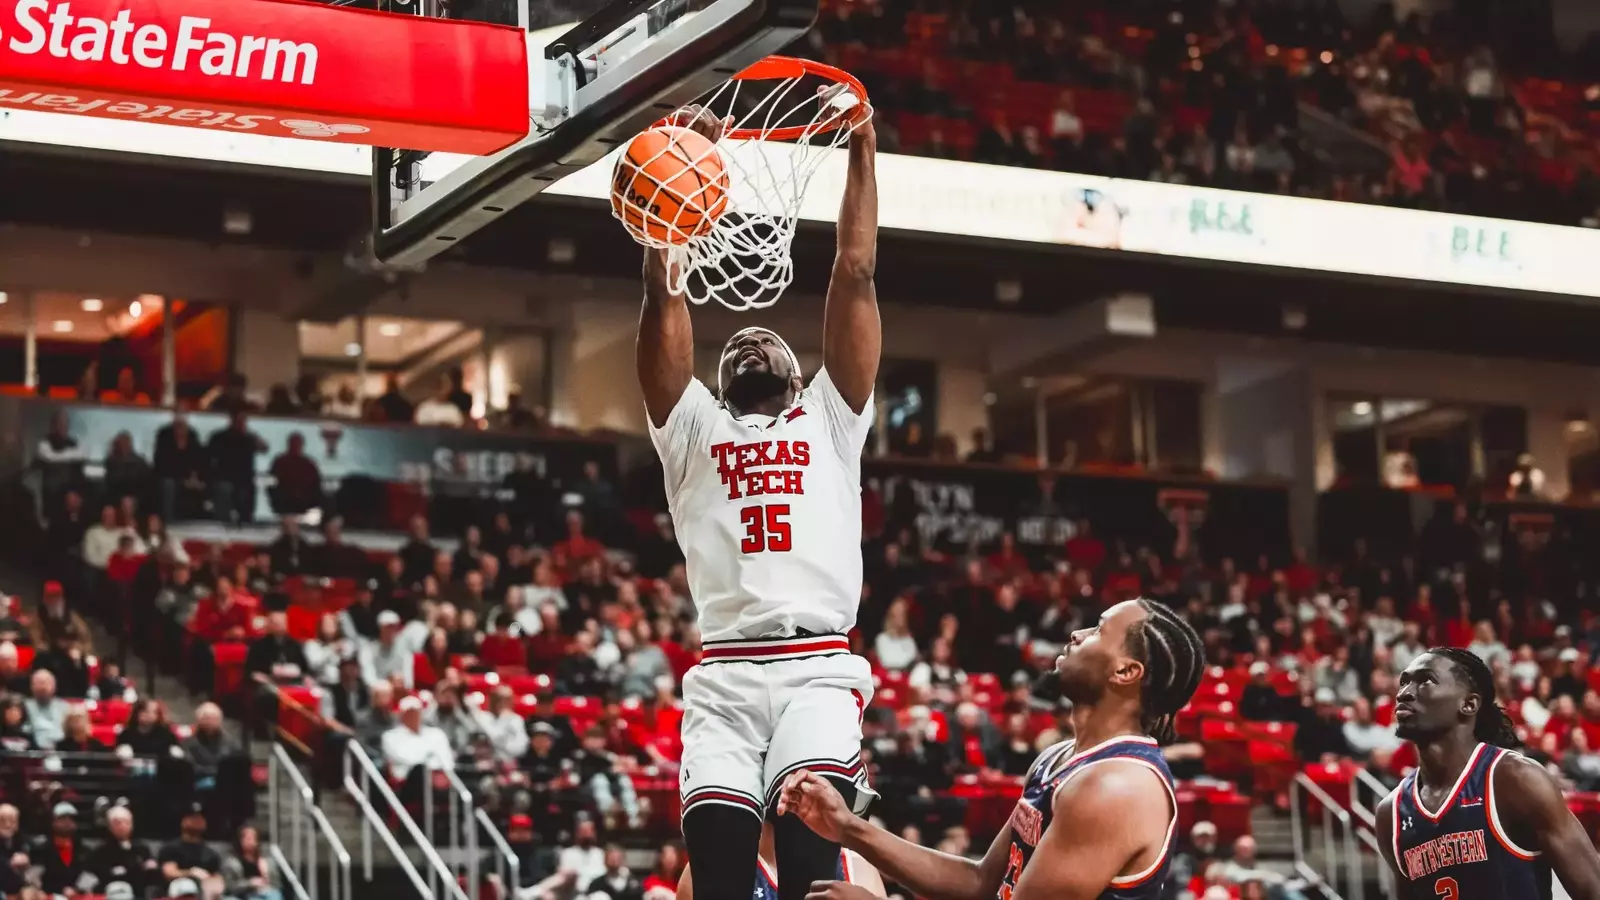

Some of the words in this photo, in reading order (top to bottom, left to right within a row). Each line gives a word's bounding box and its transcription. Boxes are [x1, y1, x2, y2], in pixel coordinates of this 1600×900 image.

[710, 440, 811, 473] TEXAS
[717, 468, 804, 500] TECH
[740, 504, 792, 554] 35
